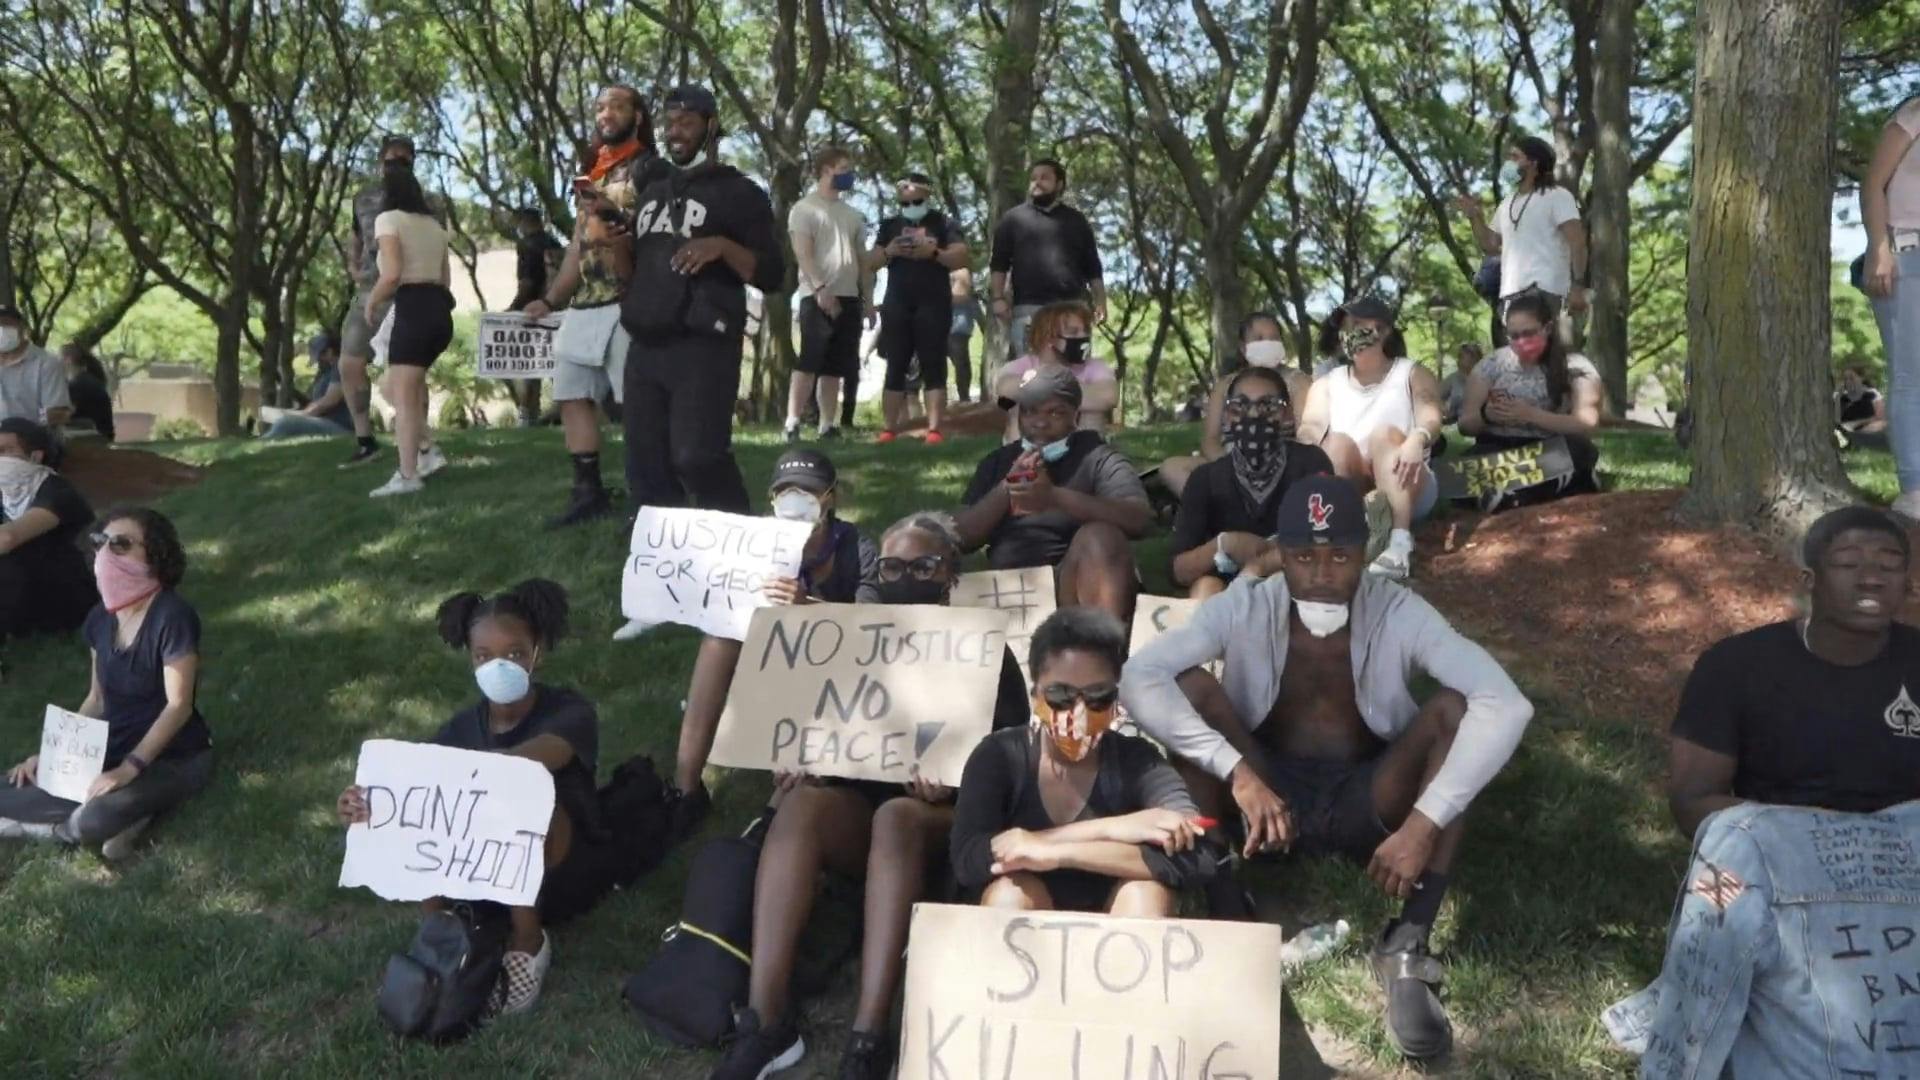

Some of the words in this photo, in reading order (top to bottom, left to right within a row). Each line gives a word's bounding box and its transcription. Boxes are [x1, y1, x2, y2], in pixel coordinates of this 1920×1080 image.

[636, 198, 707, 240] GAP
[493, 330, 552, 344] FLOYD
[647, 517, 790, 567] JUSTICE
[634, 554, 697, 583] FOR
[706, 562, 765, 594] GEO
[760, 619, 844, 672] NO
[855, 621, 1004, 668] JUSTICE
[814, 673, 891, 723] NO
[771, 717, 946, 775] PEACE!
[367, 768, 489, 841] DON'T
[404, 829, 546, 893] SHOOT
[987, 916, 1203, 1005] STOP
[1832, 924, 1872, 960] I
[1862, 973, 1920, 1007] BA
